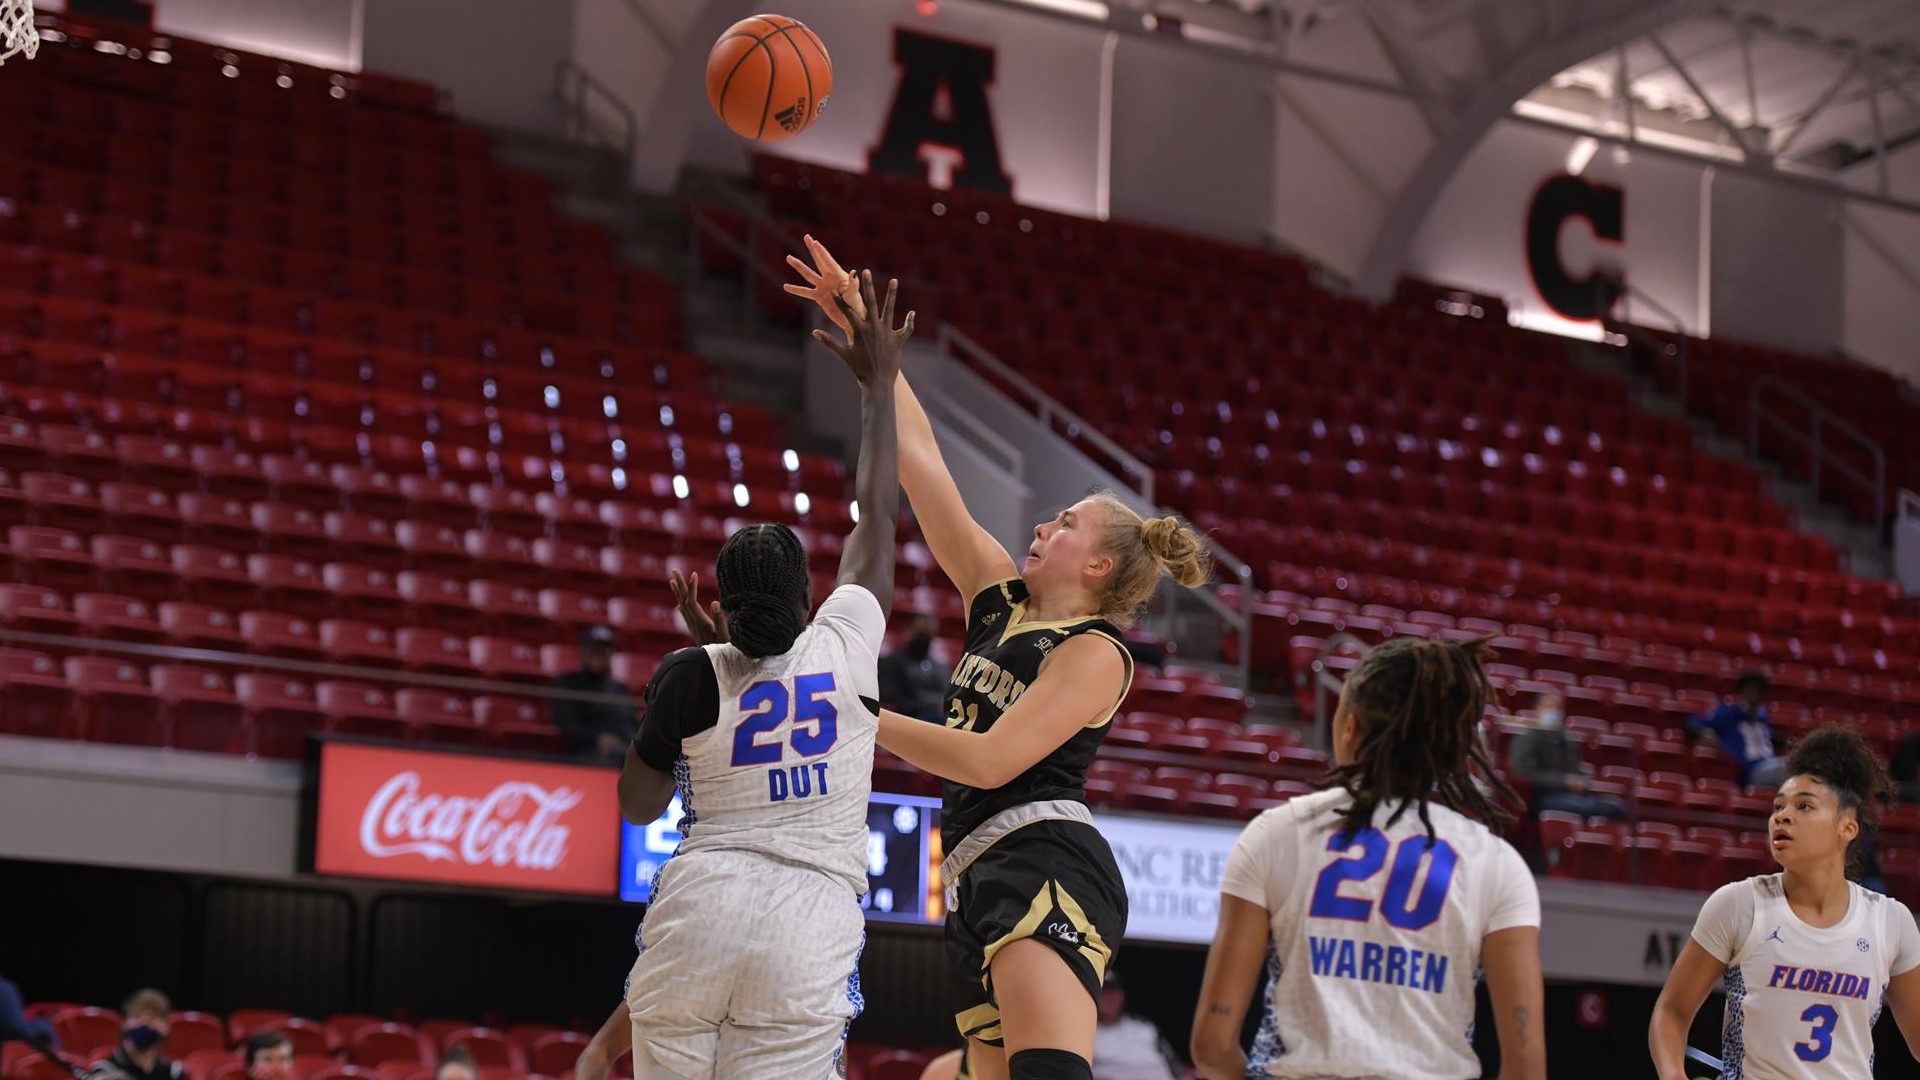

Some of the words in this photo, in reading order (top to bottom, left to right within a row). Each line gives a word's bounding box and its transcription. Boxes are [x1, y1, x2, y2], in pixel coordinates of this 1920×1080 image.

[866, 25, 1014, 199] A
[1526, 172, 1626, 321] C
[730, 672, 838, 767] 25
[768, 762, 828, 801] DUT
[1308, 826, 1459, 931] 20
[1308, 936, 1448, 994] WARREN
[1766, 964, 1870, 1000] FLORIDA
[1794, 1003, 1839, 1062] 3
